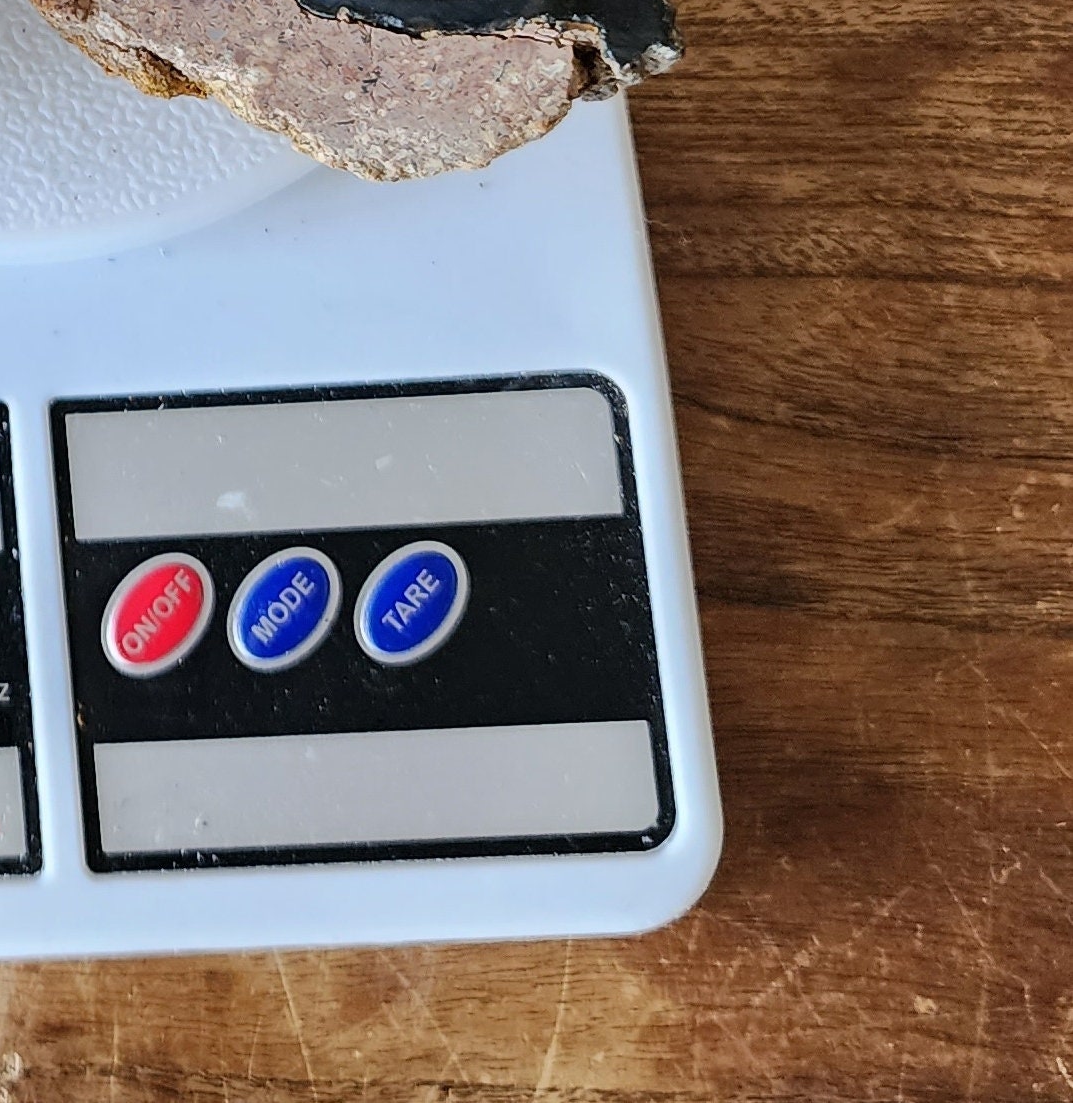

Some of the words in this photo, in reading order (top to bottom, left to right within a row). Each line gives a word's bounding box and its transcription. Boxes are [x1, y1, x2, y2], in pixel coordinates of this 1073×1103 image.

[121, 569, 194, 656] ON/OFF
[250, 571, 315, 645] MODE
[381, 568, 442, 634] TARE
